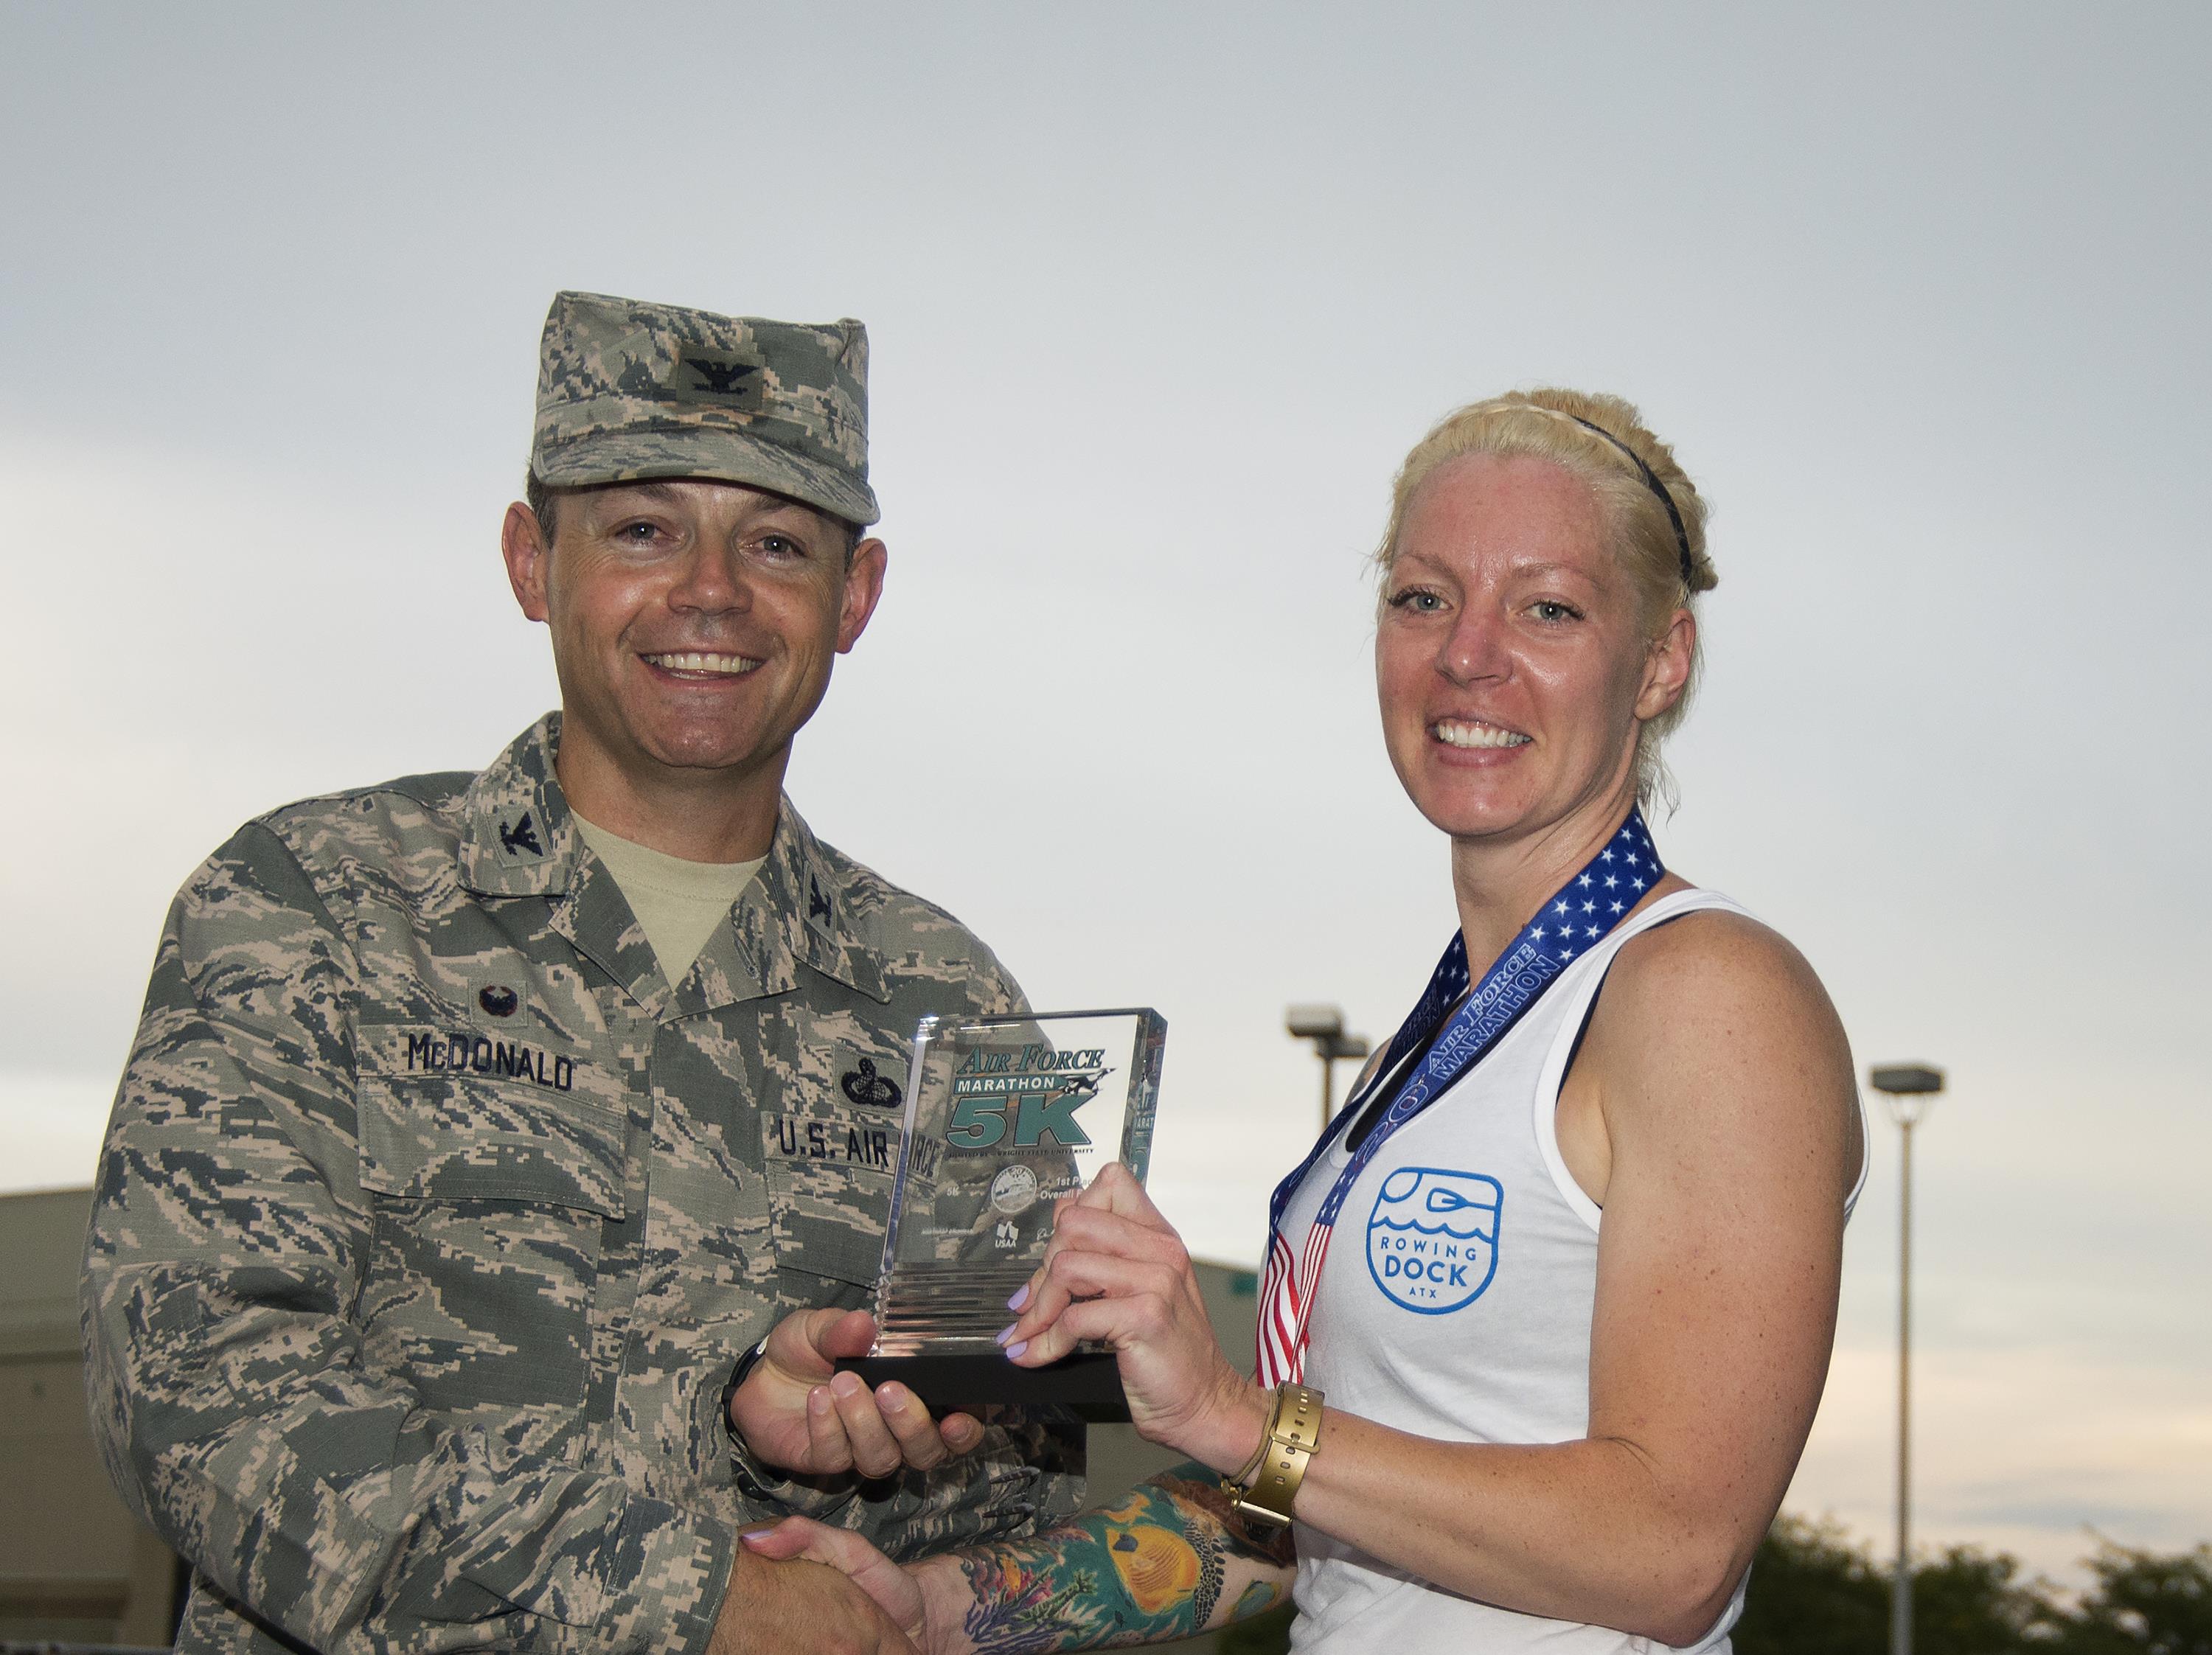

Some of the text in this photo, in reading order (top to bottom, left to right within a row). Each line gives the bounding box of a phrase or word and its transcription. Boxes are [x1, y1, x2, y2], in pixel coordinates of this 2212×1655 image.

[1429, 943, 1537, 1074] AIR FORCE
[1433, 954, 1561, 1081] MARATHON
[408, 1033, 573, 1091] McDONALD
[956, 1043, 1106, 1073] AIR FORCE
[958, 1076, 1055, 1093] MARATHON
[946, 1093, 1097, 1149] 5K
[779, 1119, 835, 1158] U.S.
[847, 1127, 889, 1167] AIR
[1050, 1147, 1094, 1156] UNIVERSITY
[1040, 1188, 1074, 1200] Overall
[1057, 1177, 1070, 1186] 1st
[995, 1239, 1017, 1248] USAA
[1380, 1236, 1476, 1261] ROWING
[1385, 1255, 1468, 1287] DOCK
[1409, 1286, 1436, 1298] ATX
